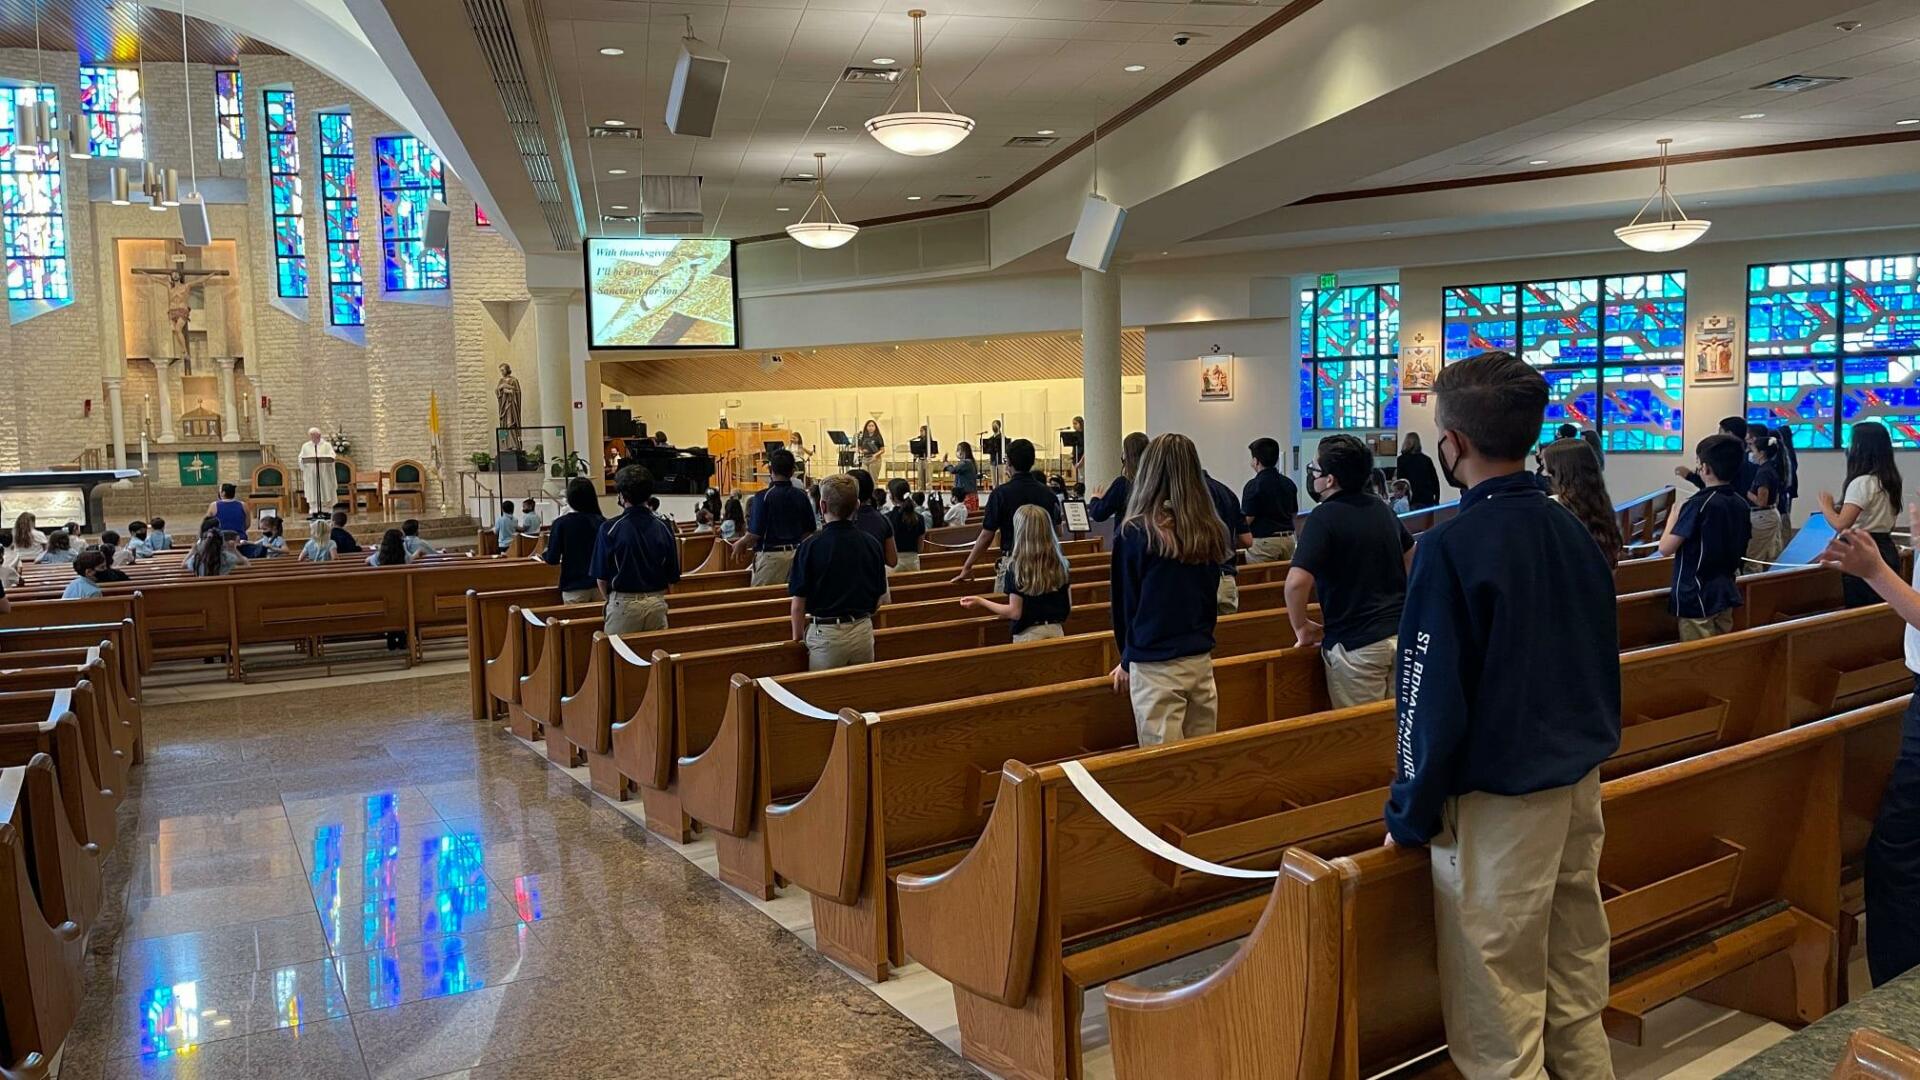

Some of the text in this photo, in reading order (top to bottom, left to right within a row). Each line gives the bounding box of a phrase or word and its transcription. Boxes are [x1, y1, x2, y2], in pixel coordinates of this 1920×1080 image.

[596, 248, 617, 257] With
[662, 286, 678, 295] You
[1401, 648, 1413, 703] CATHOLIC
[1402, 631, 1430, 781] ST. BONAVENTURE
